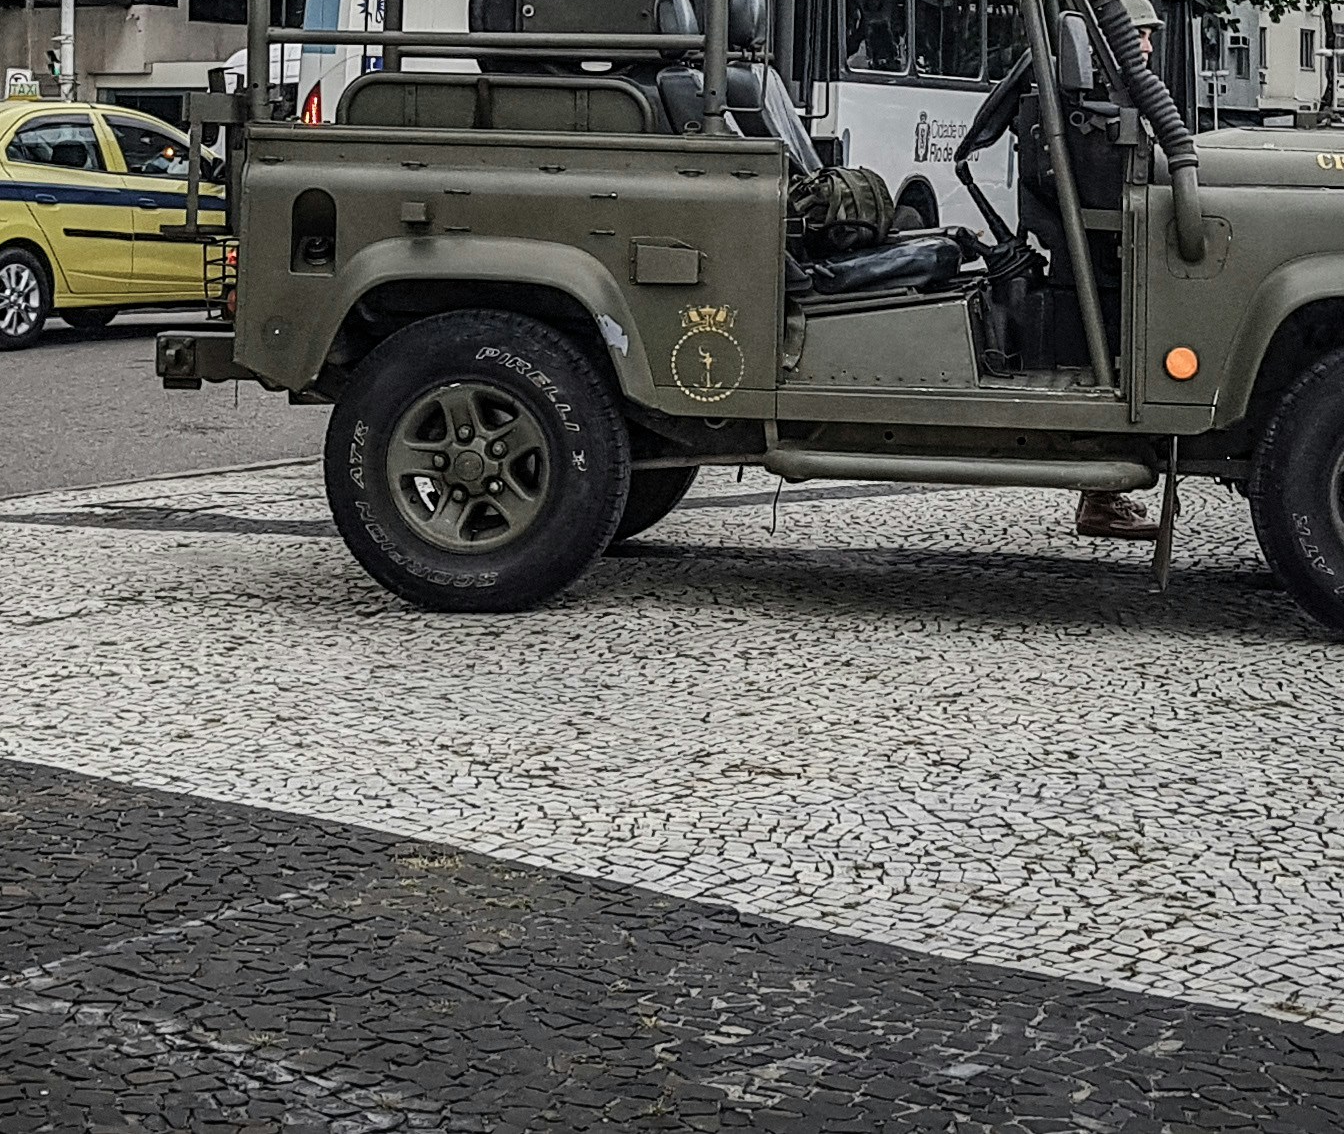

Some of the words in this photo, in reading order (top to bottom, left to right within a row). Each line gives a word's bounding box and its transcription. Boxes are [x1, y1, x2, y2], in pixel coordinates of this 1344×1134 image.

[11, 83, 37, 95] TAXI
[476, 347, 580, 432] PIRELLI
[350, 420, 369, 489] ATR
[355, 501, 499, 587] SCORPION
[1292, 513, 1335, 575] ATR
